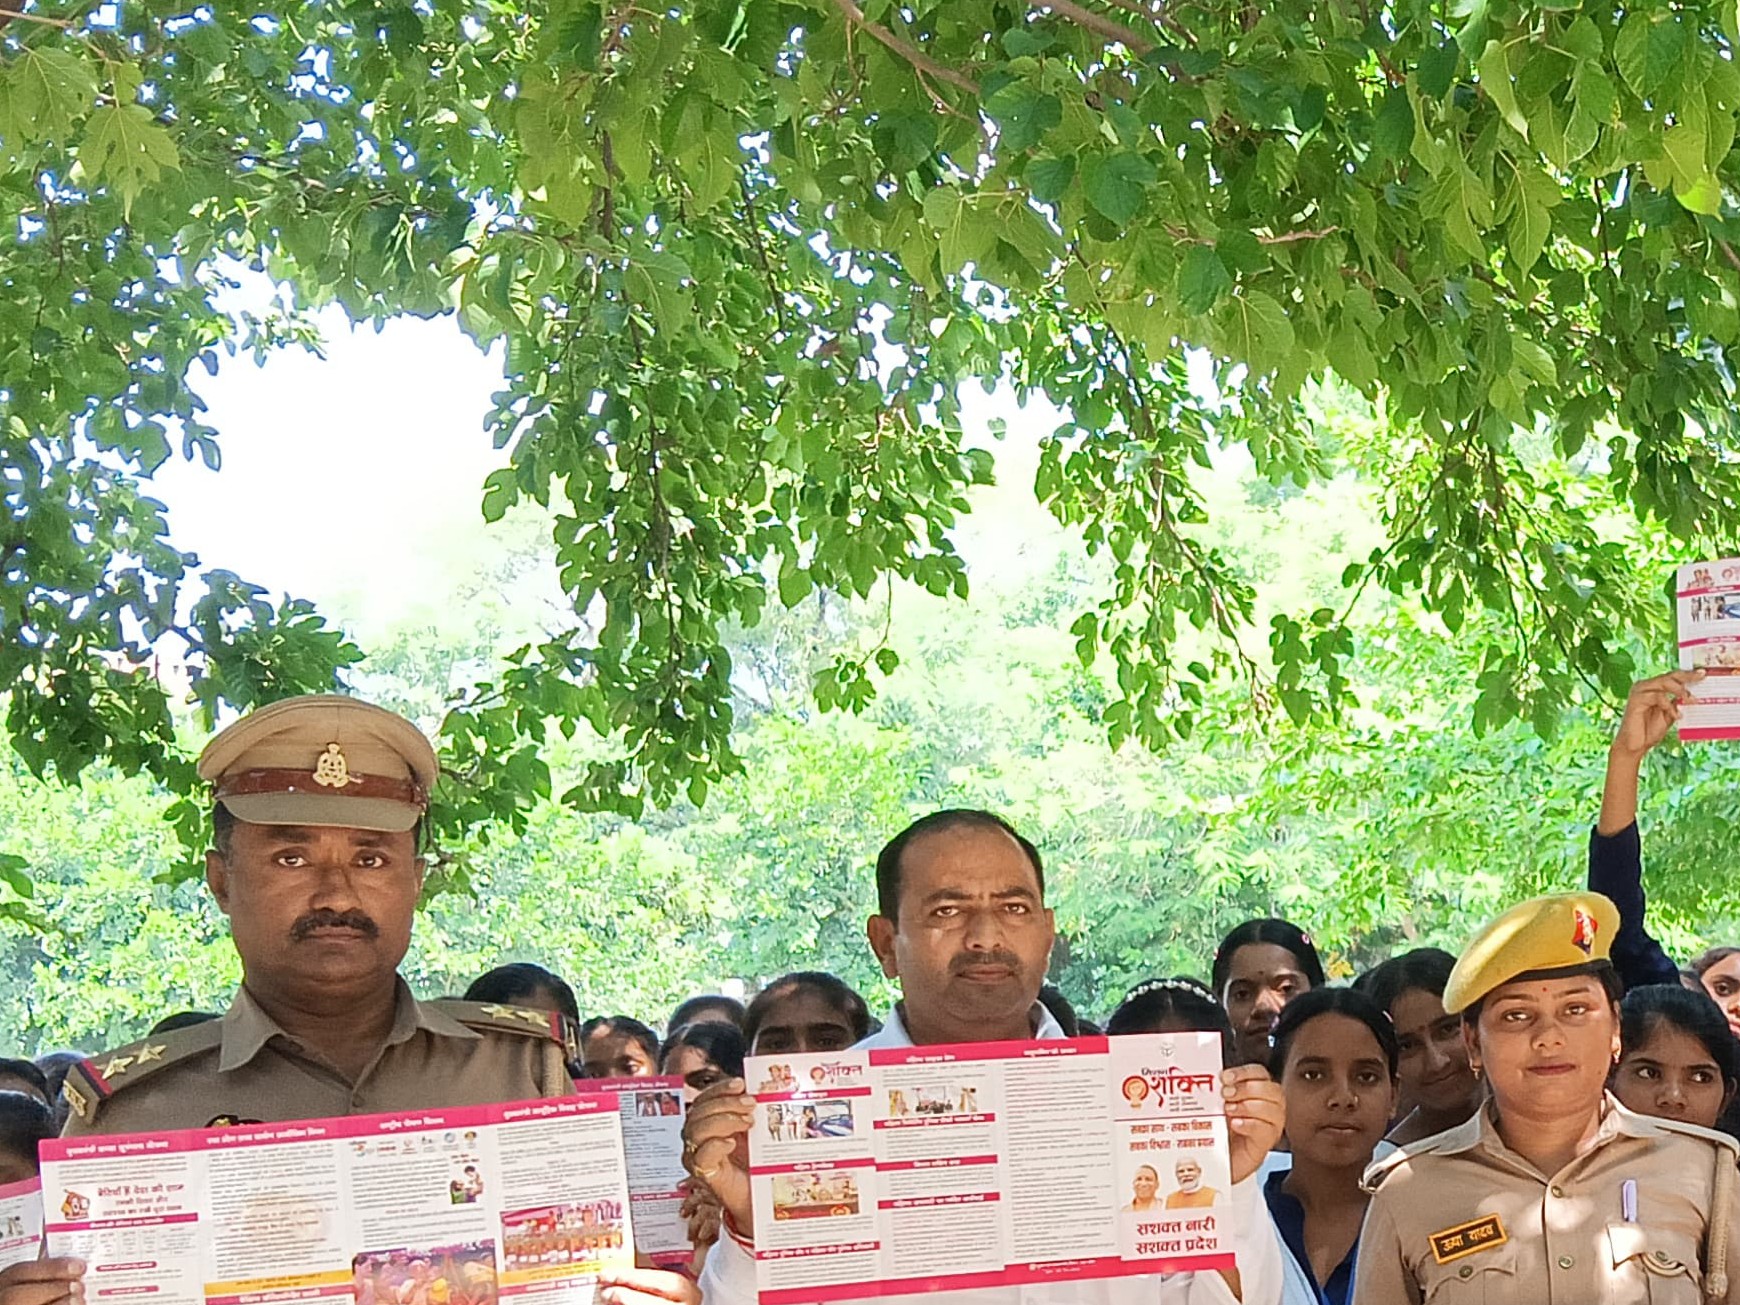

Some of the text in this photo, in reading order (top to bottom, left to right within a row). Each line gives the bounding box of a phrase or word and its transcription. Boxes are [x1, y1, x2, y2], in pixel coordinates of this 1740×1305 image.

[1150, 1066, 1215, 1108] शक्ति
[1136, 1216, 1216, 1236] सशक्त नारी
[1467, 1224, 1494, 1241] यादव
[1136, 1235, 1218, 1254] सशक्त प्रदेश
